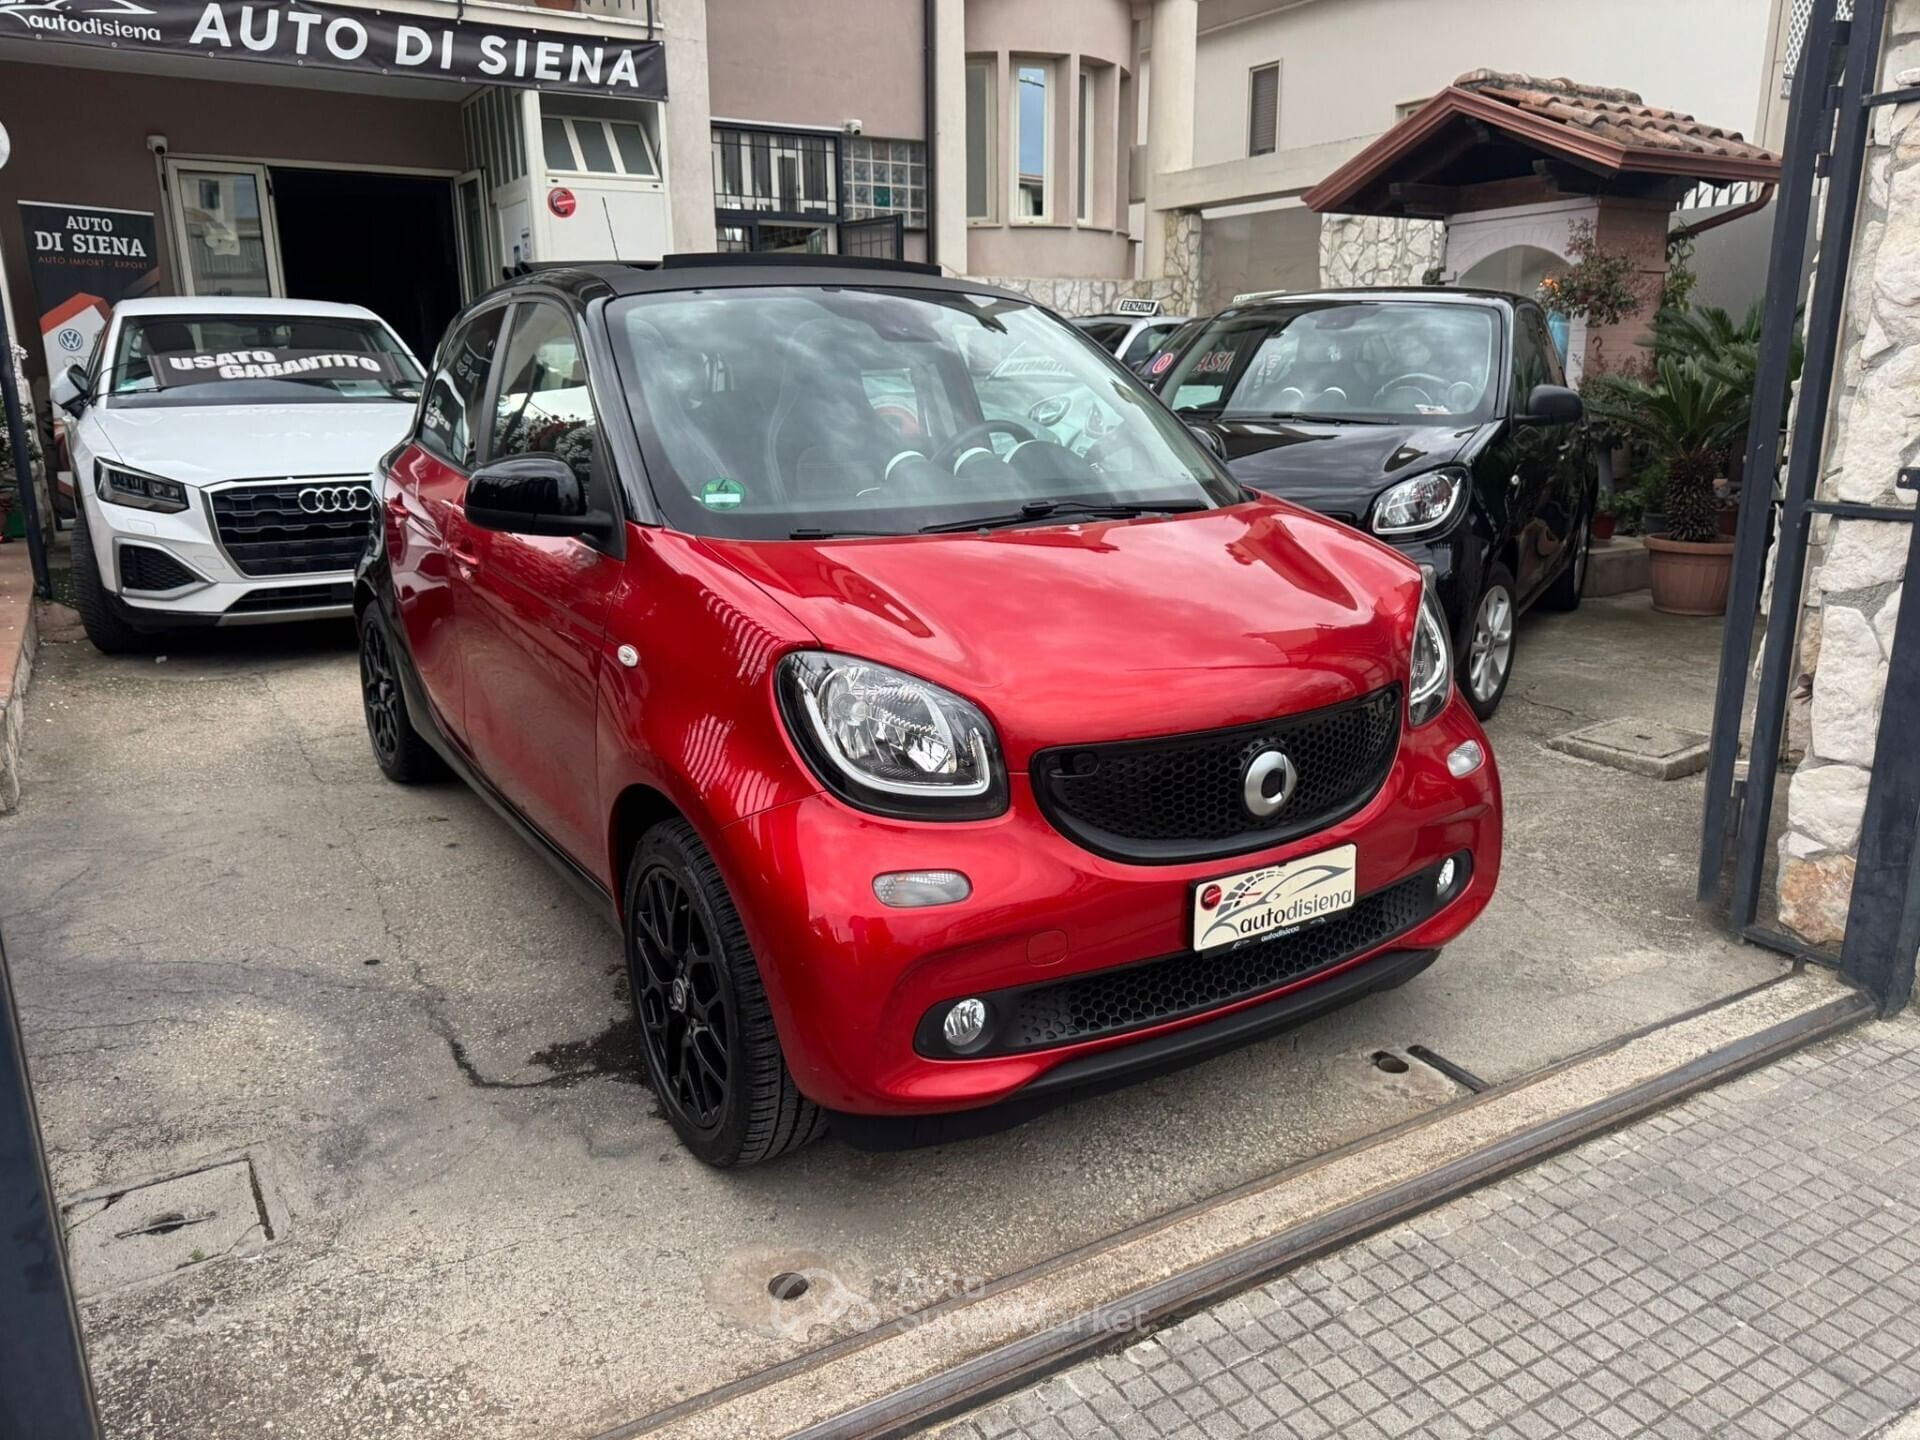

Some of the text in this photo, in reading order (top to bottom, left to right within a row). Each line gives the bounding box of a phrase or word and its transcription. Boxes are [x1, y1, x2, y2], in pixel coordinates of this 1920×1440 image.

[28, 13, 161, 41] autodisiena
[189, 2, 640, 88] AUTO DI SIENA
[65, 215, 113, 232] AUTO
[34, 230, 147, 257] DI SIENA
[38, 256, 66, 265] AUTO
[69, 257, 105, 267] IMPORT
[114, 260, 148, 270] EXPORT
[1120, 301, 1153, 312] BENZINA
[169, 350, 277, 371] USATO
[218, 354, 382, 379] GARANTITO
[1240, 887, 1352, 934] autodisiena
[1261, 925, 1300, 943] autodisiena
